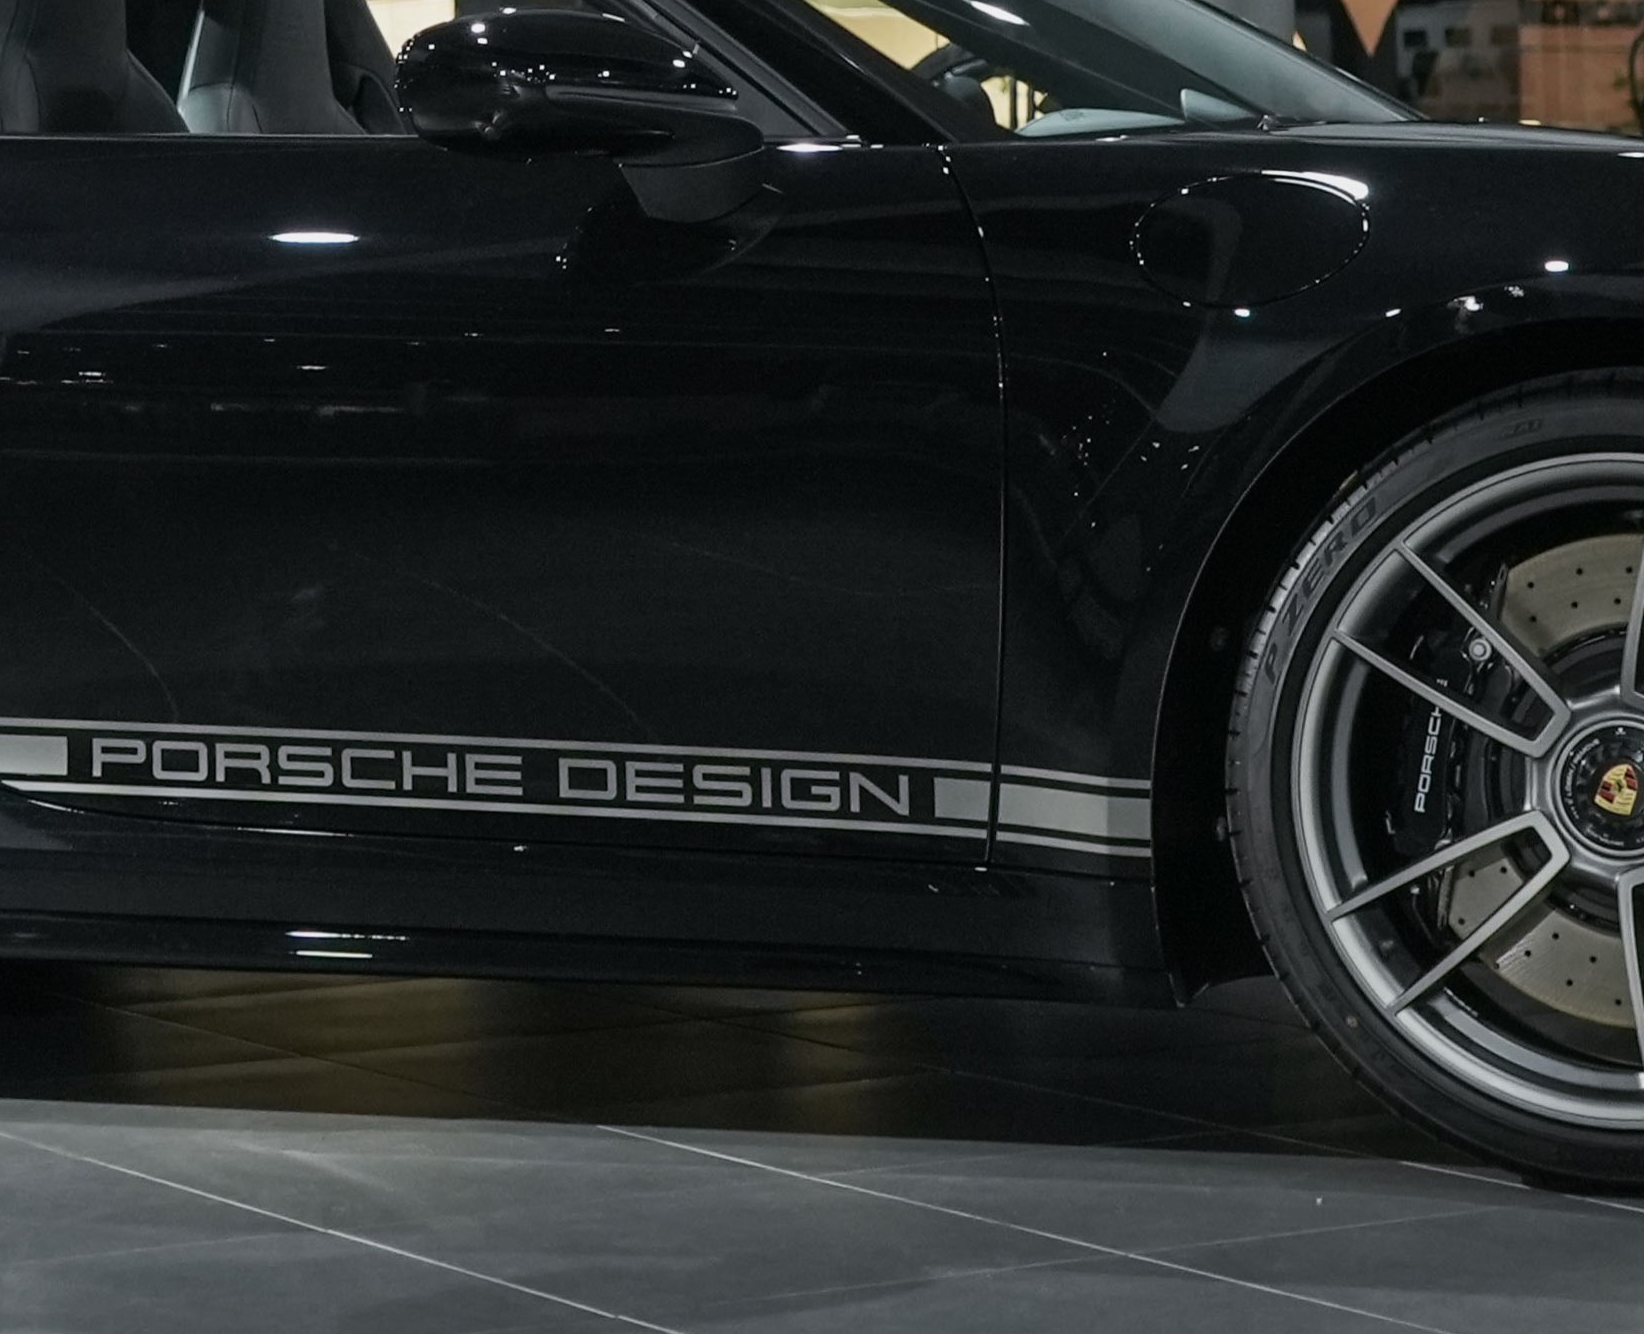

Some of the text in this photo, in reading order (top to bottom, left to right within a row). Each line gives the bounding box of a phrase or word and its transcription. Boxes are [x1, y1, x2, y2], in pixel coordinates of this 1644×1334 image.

[1264, 497, 1378, 685] P ZERO
[91, 736, 911, 817] PORSCHE DESIGN
